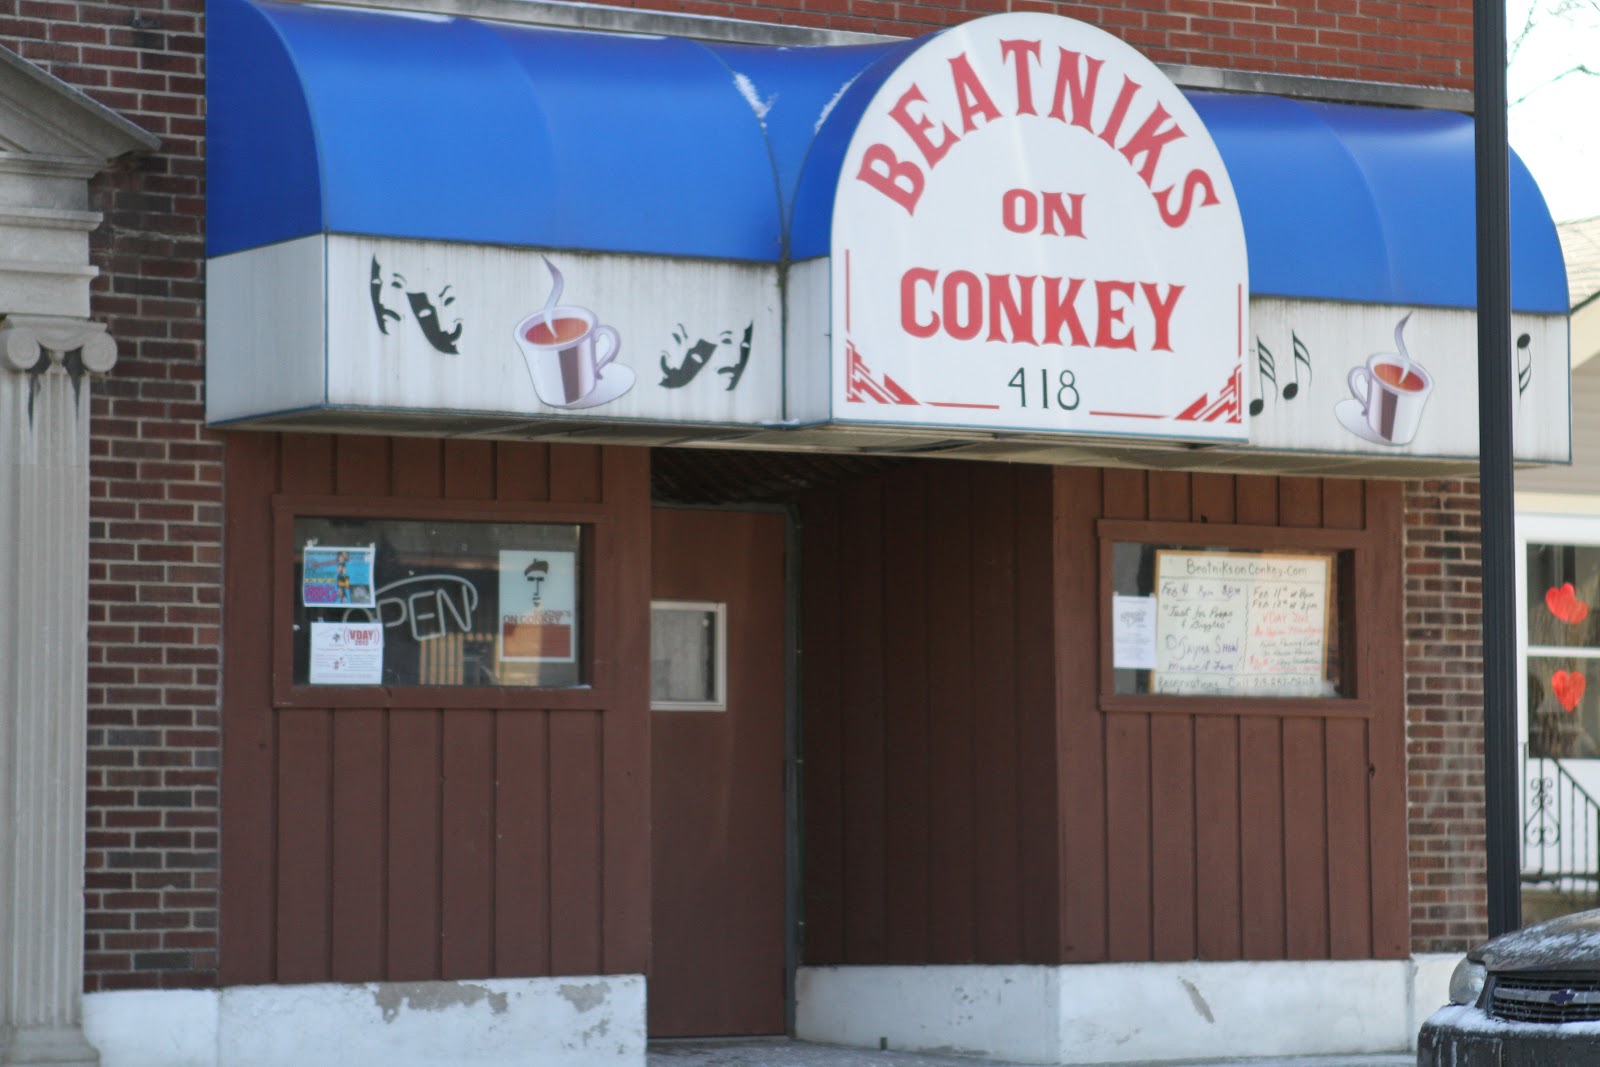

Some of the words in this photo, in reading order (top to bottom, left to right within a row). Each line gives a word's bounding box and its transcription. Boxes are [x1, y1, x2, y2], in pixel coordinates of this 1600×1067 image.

[856, 38, 1221, 228] BEATNIKS
[1002, 188, 1087, 239] ON
[900, 267, 1186, 352] CONKEY
[1008, 367, 1080, 410] 418
[349, 629, 375, 641] VDAY
